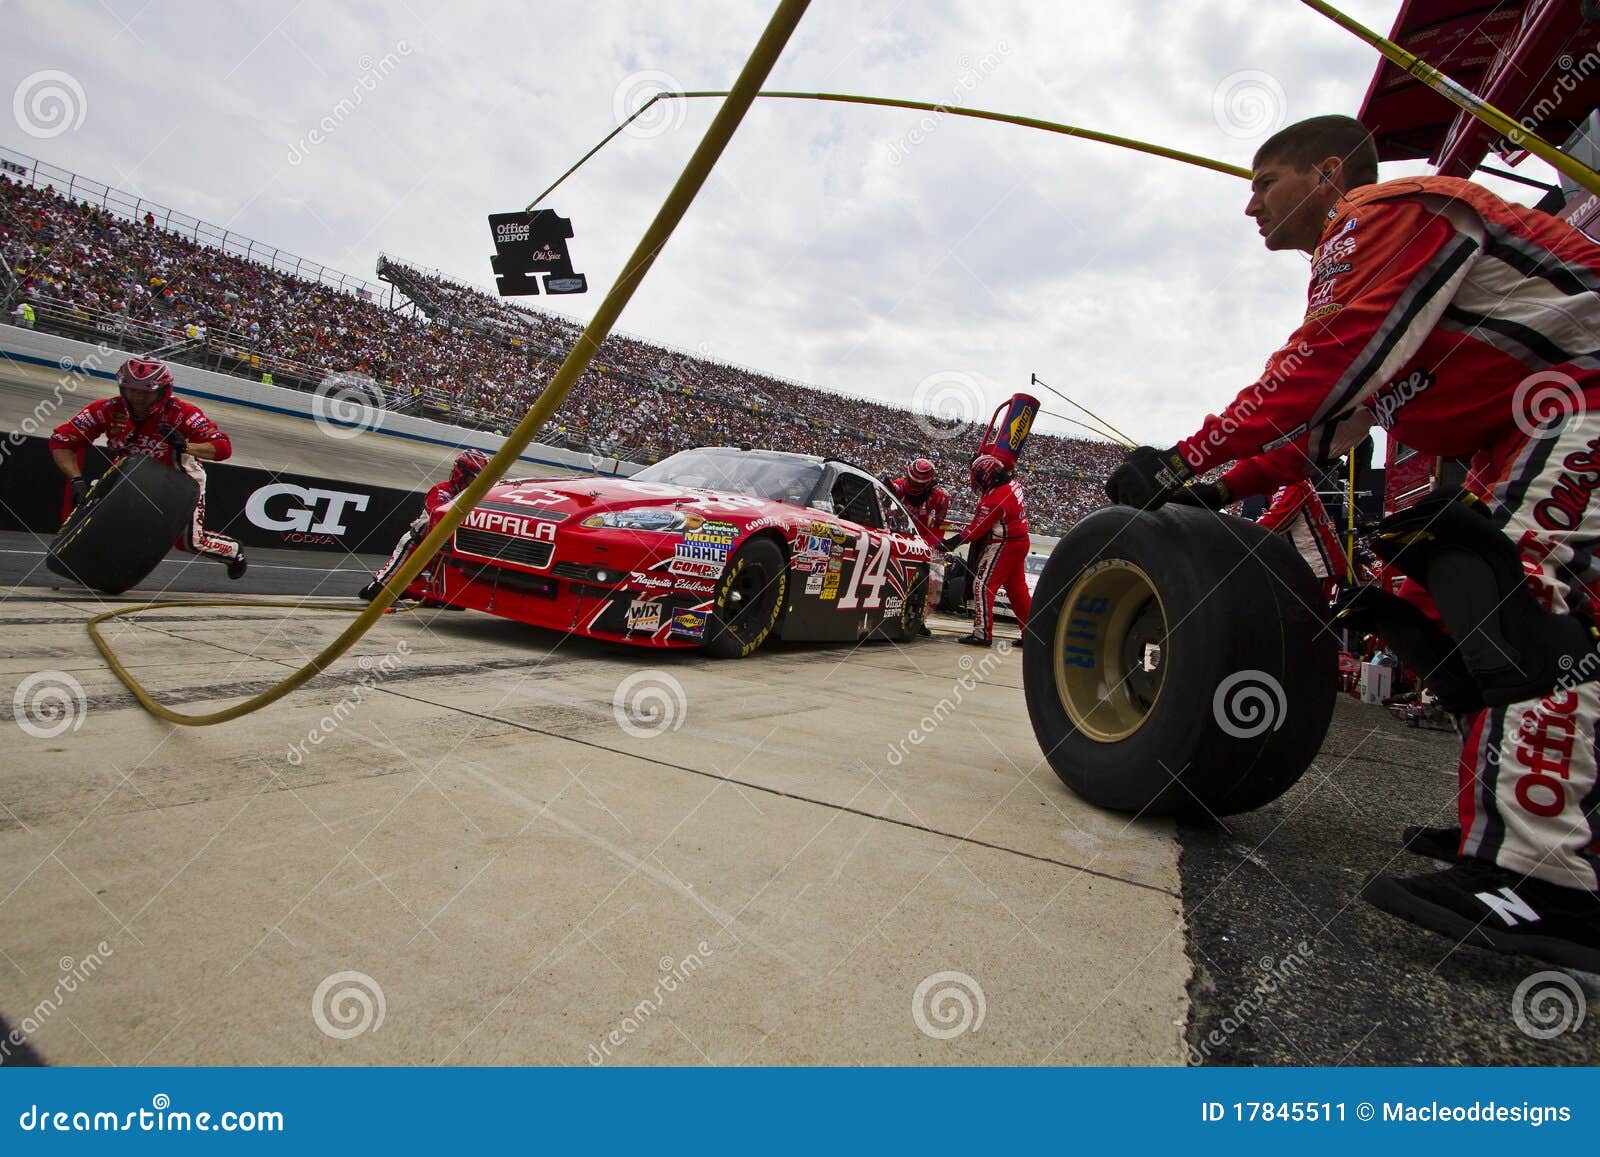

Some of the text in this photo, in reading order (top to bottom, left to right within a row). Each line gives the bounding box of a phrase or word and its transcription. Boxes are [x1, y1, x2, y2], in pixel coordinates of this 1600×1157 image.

[497, 223, 530, 236] Office
[498, 233, 530, 242] DEPOT
[1010, 406, 1032, 450] SUNOCO
[245, 483, 370, 535] GT
[281, 533, 335, 545] VODKA
[685, 533, 732, 545] MOOG
[676, 545, 727, 563] MAHLE
[672, 560, 712, 574] COMP
[837, 531, 892, 608] 14
[674, 578, 716, 594] Edelbrock
[631, 603, 659, 619] WIX
[674, 615, 705, 626] SUNOCO
